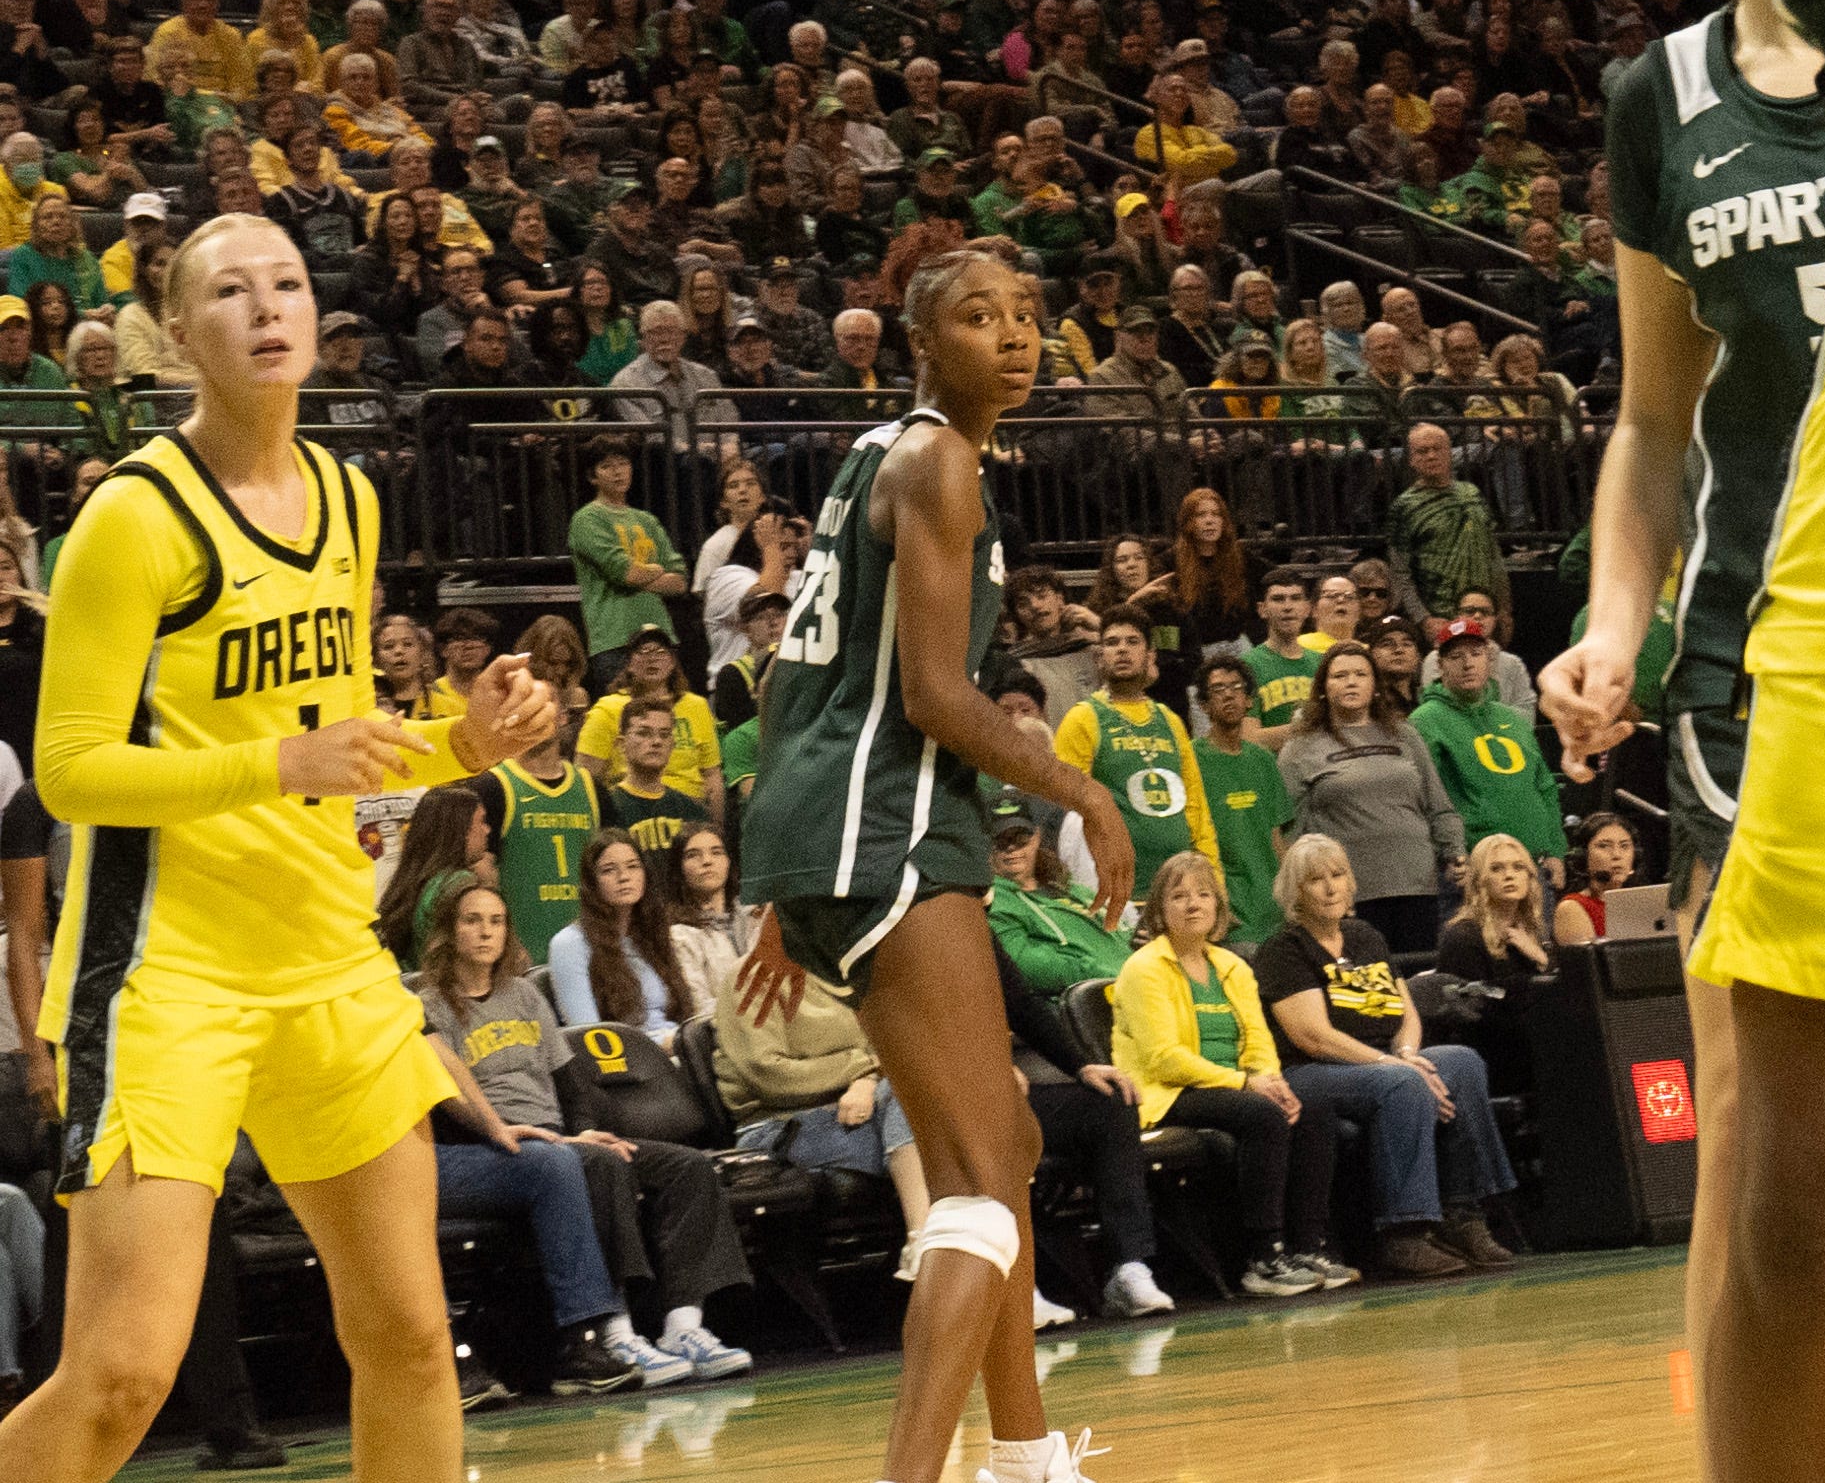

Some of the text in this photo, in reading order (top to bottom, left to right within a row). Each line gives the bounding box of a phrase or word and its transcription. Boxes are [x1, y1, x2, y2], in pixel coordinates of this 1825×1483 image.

[778, 549, 841, 666] 23
[1473, 733, 1527, 775] O
[551, 834, 569, 878] 1
